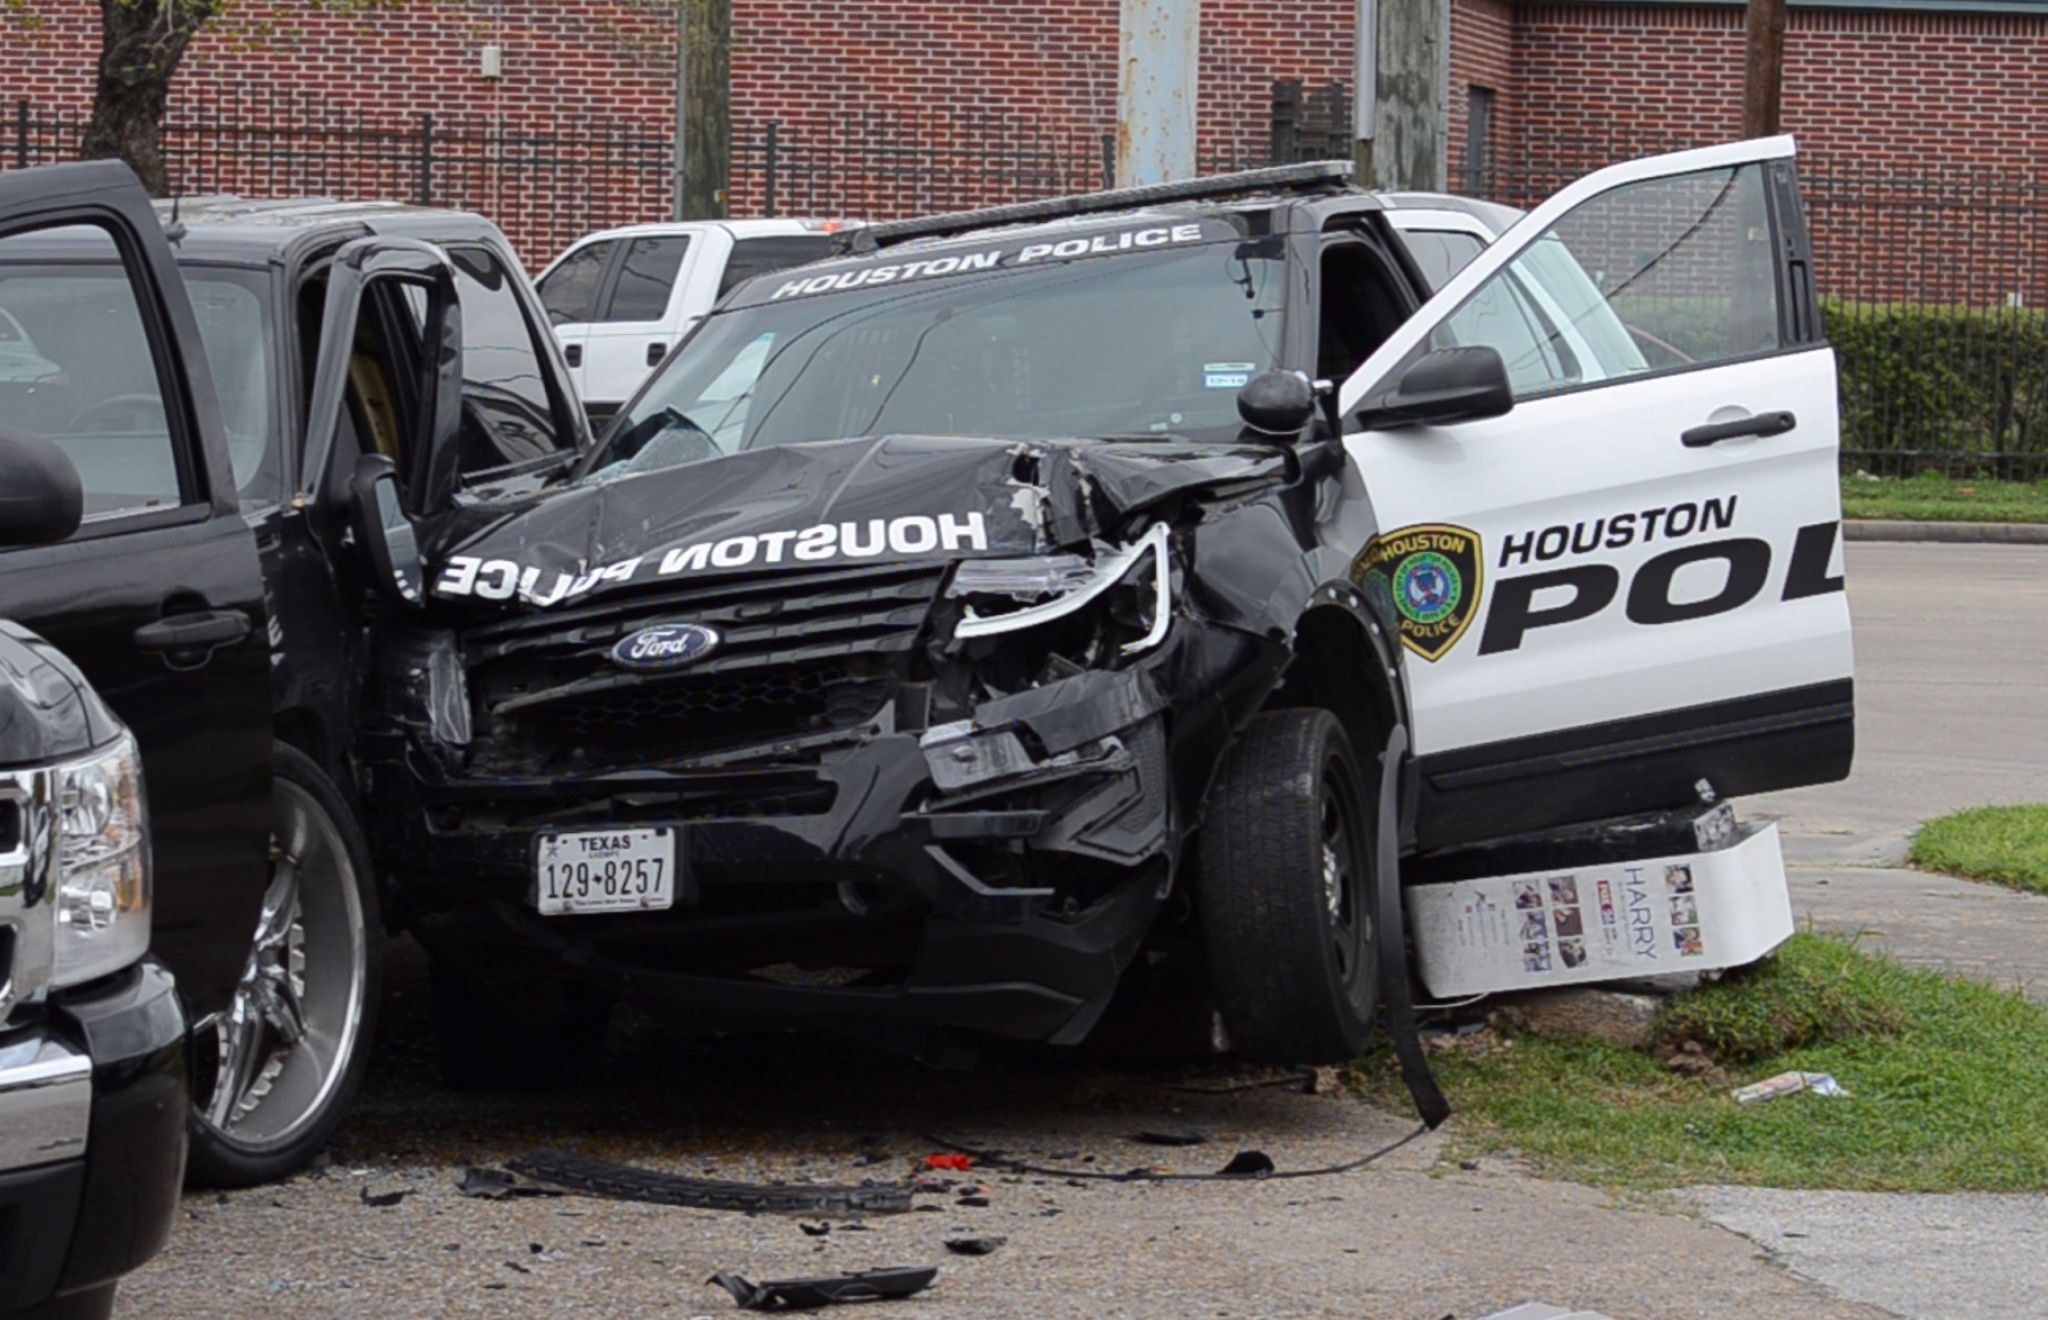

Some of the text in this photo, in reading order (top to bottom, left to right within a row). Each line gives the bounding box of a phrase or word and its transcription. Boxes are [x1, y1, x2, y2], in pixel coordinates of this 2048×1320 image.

[771, 222, 1203, 299] HOUSTON POLICE
[1498, 495, 1738, 568] HOUSTON
[1380, 534, 1466, 561] HOUSTON
[1401, 613, 1460, 638] POLICE
[630, 629, 691, 659] Ford
[578, 834, 632, 852] TEXAS
[1624, 867, 1658, 959] HARRY
